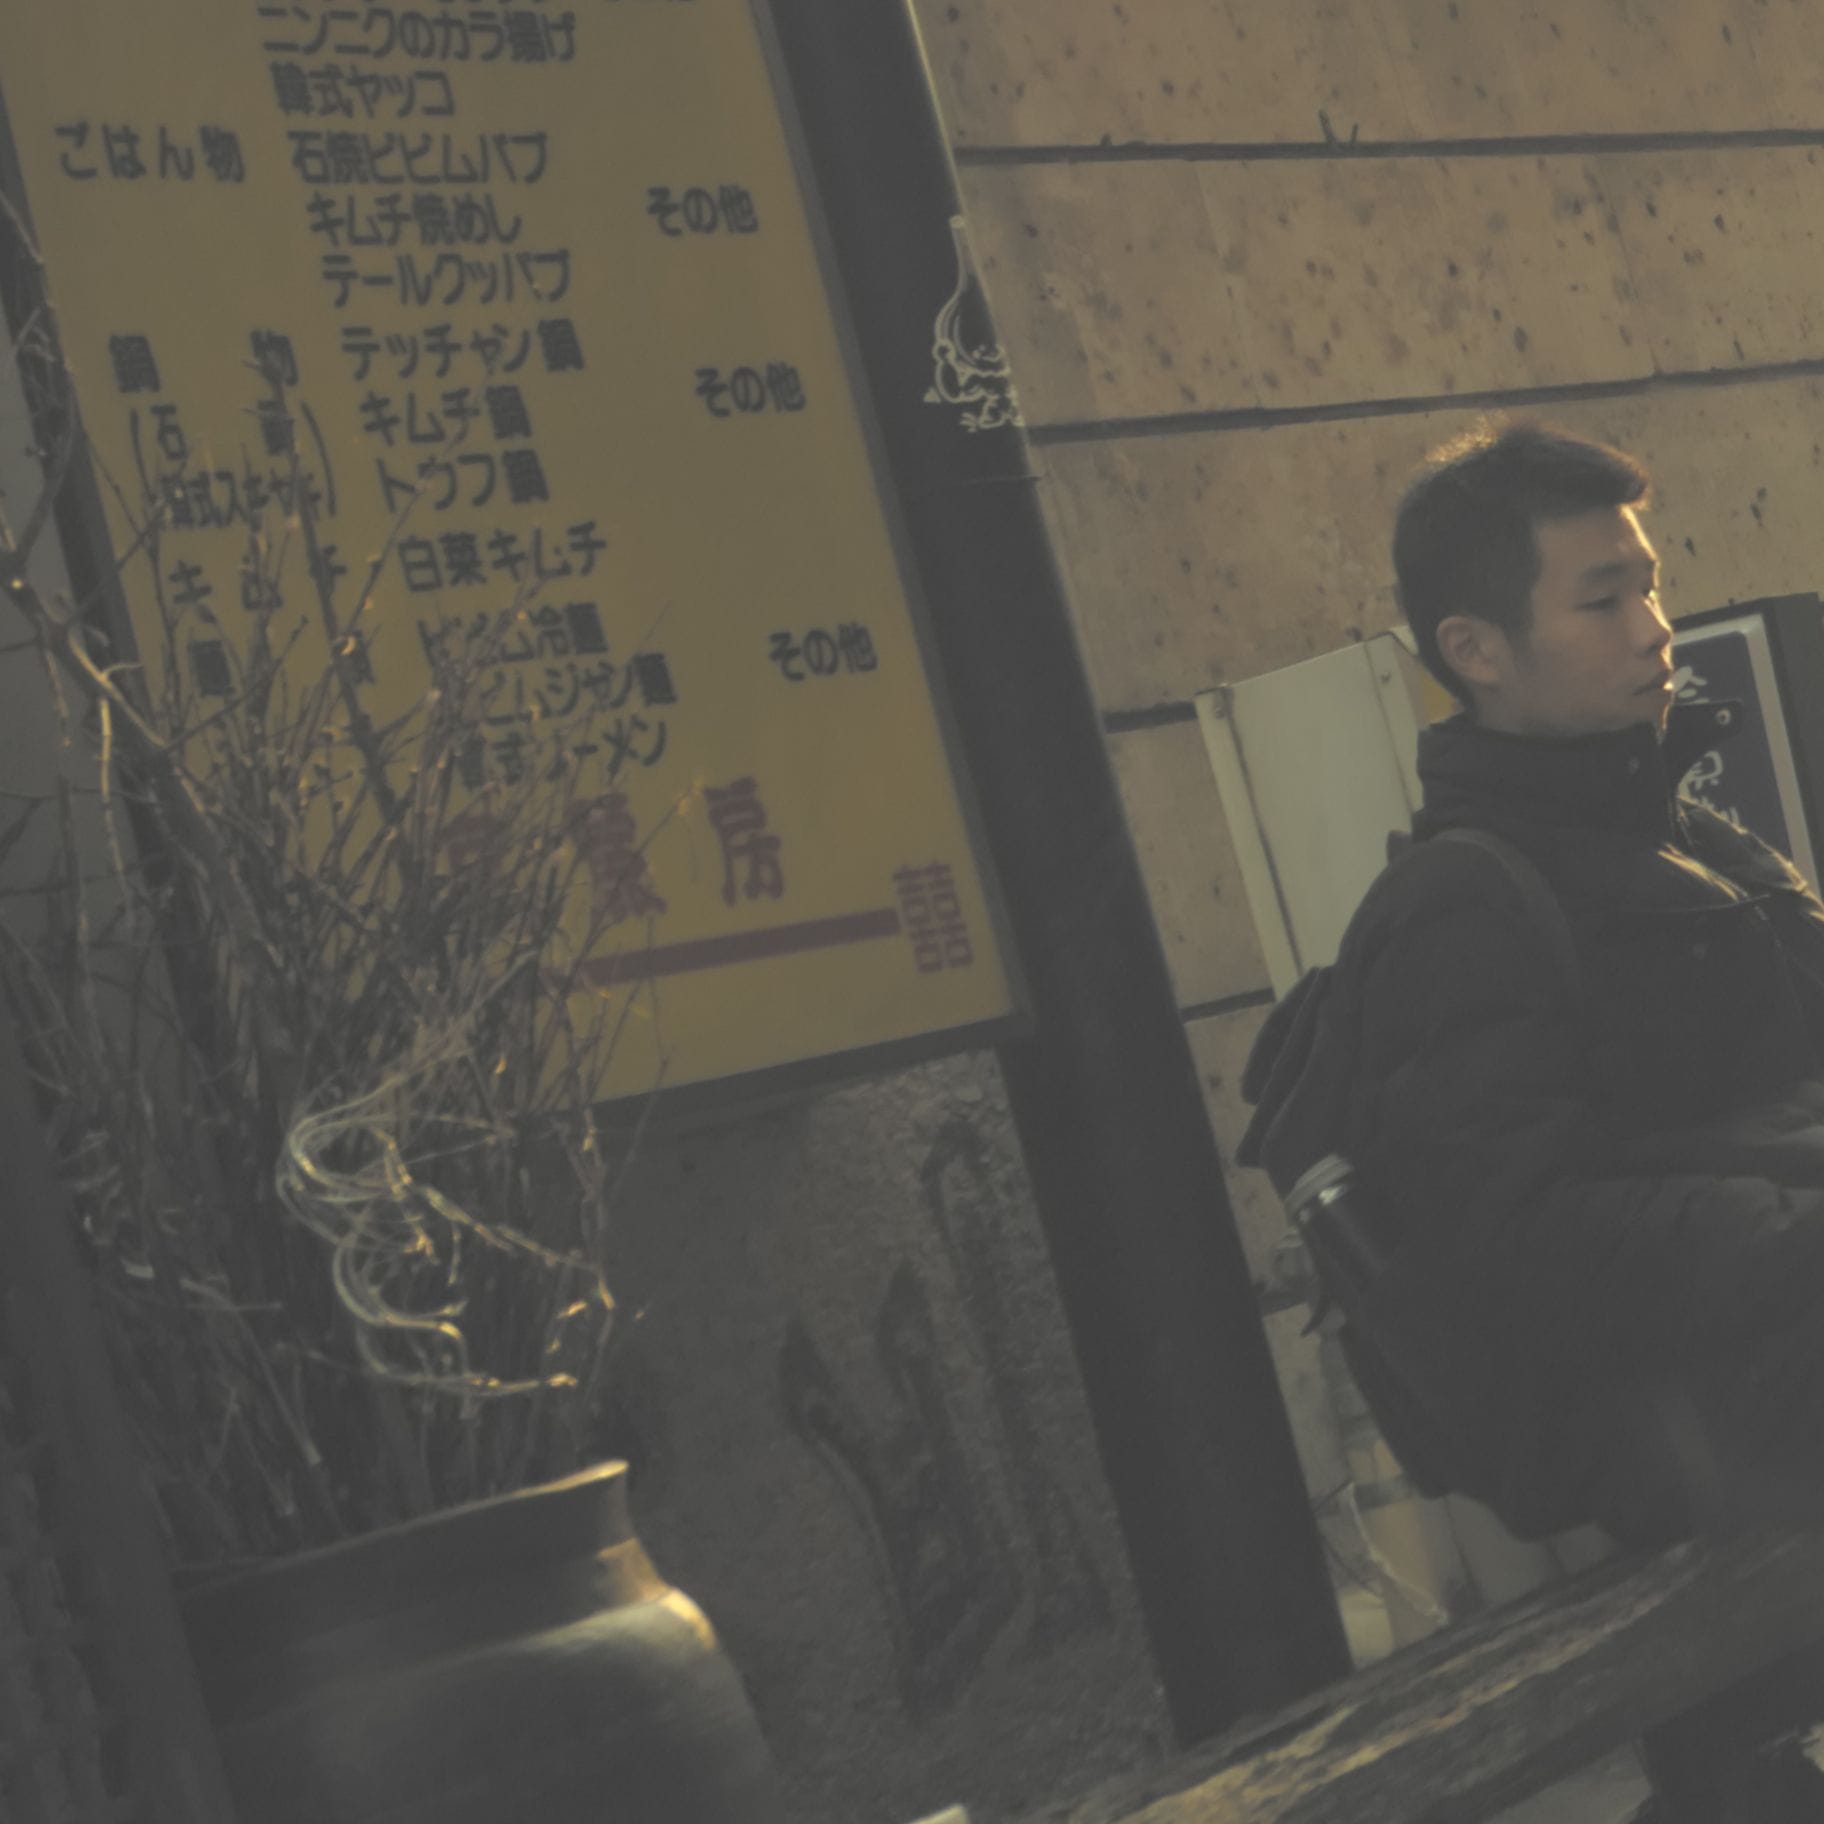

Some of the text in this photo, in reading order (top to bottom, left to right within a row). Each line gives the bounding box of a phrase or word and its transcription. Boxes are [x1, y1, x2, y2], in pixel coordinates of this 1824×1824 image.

[258, 5, 575, 61] ニンニクのカラ揚げ
[54, 120, 245, 183] ごはん物
[306, 190, 522, 247] キムチ焼めし
[646, 185, 758, 238] その他
[340, 317, 585, 382] テッチャン鍋
[359, 383, 533, 445] キムチ鍋
[694, 362, 806, 418] その他
[376, 448, 551, 513] トウフ鍋
[397, 520, 607, 595] 白菜キムチ
[767, 621, 878, 684] その他
